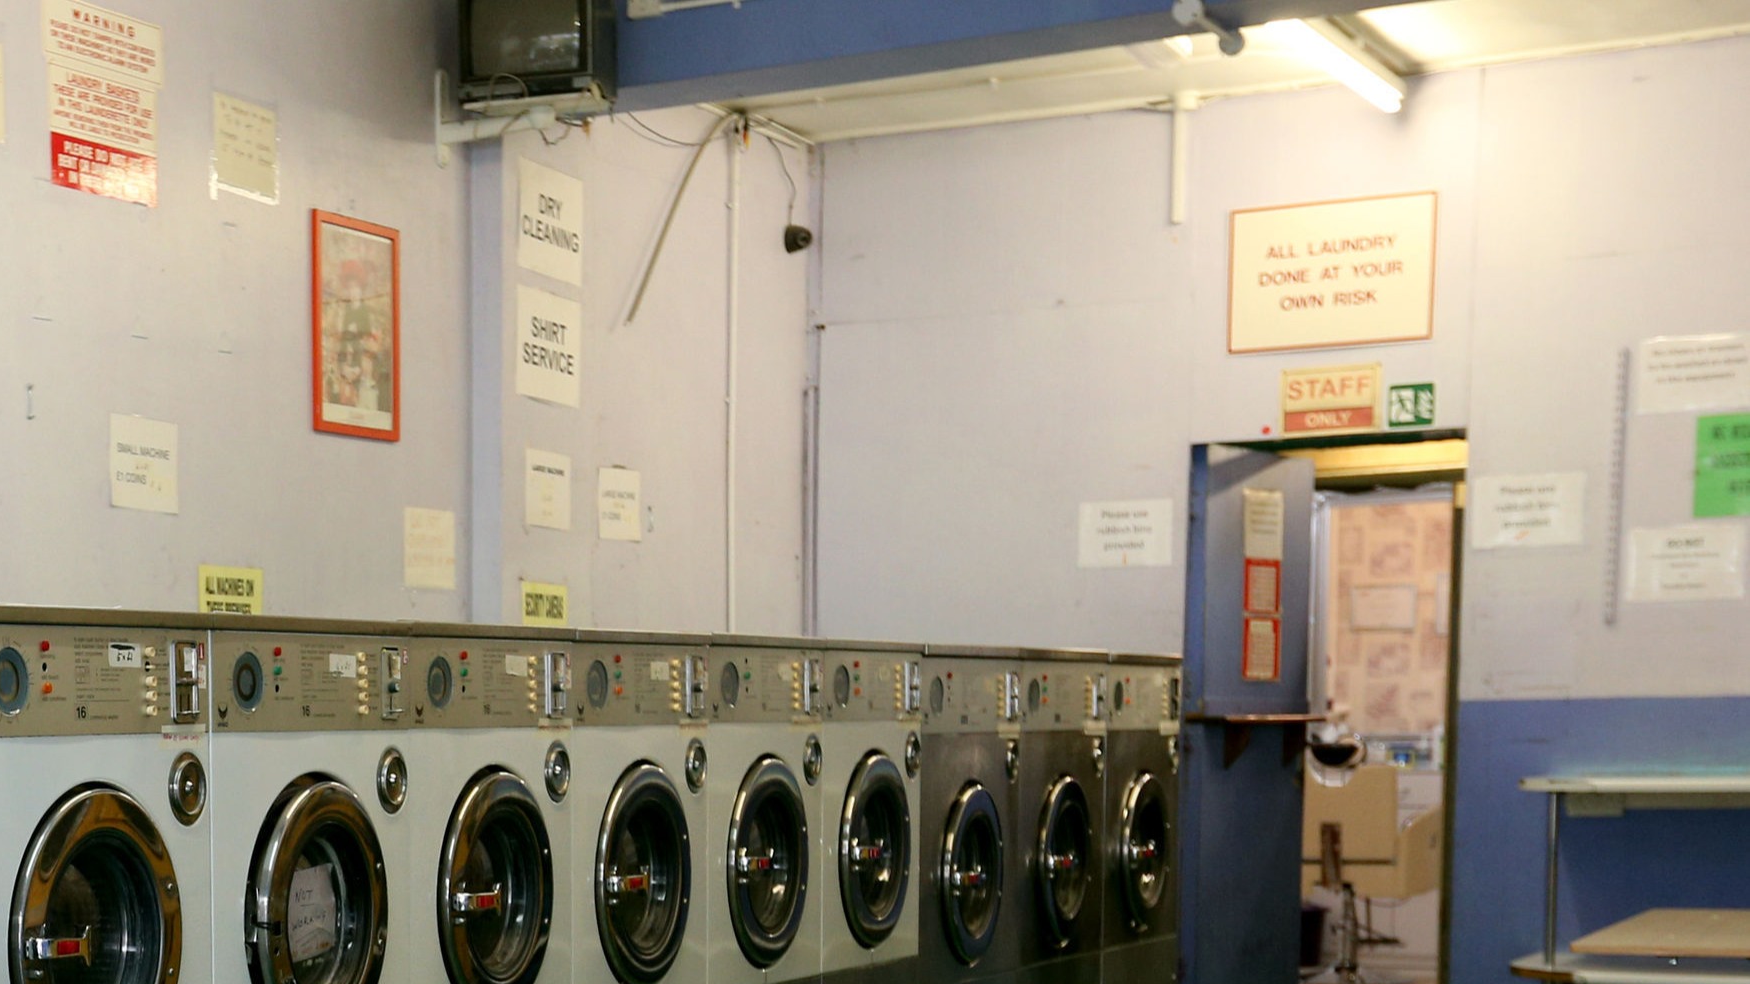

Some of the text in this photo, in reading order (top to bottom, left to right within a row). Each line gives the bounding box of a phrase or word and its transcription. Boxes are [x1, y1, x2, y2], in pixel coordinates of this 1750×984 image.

[73, 9, 135, 38] WARNING
[538, 193, 563, 221] DRY
[522, 214, 579, 254] CLEANING
[1265, 234, 1398, 260] ALL LAUNDRY
[1258, 259, 1405, 288] DONE AT YOUR
[1279, 289, 1378, 312] OWN RISK
[530, 315, 567, 346] SHIRT
[523, 342, 575, 376] SERVICE
[1287, 375, 1372, 401] STAFF
[1304, 410, 1353, 429] ONLY
[116, 442, 171, 460] SMALL MACHINE
[205, 576, 255, 597] ALL MACHINES ON
[76, 706, 87, 719] 16
[295, 888, 313, 902] NOT
